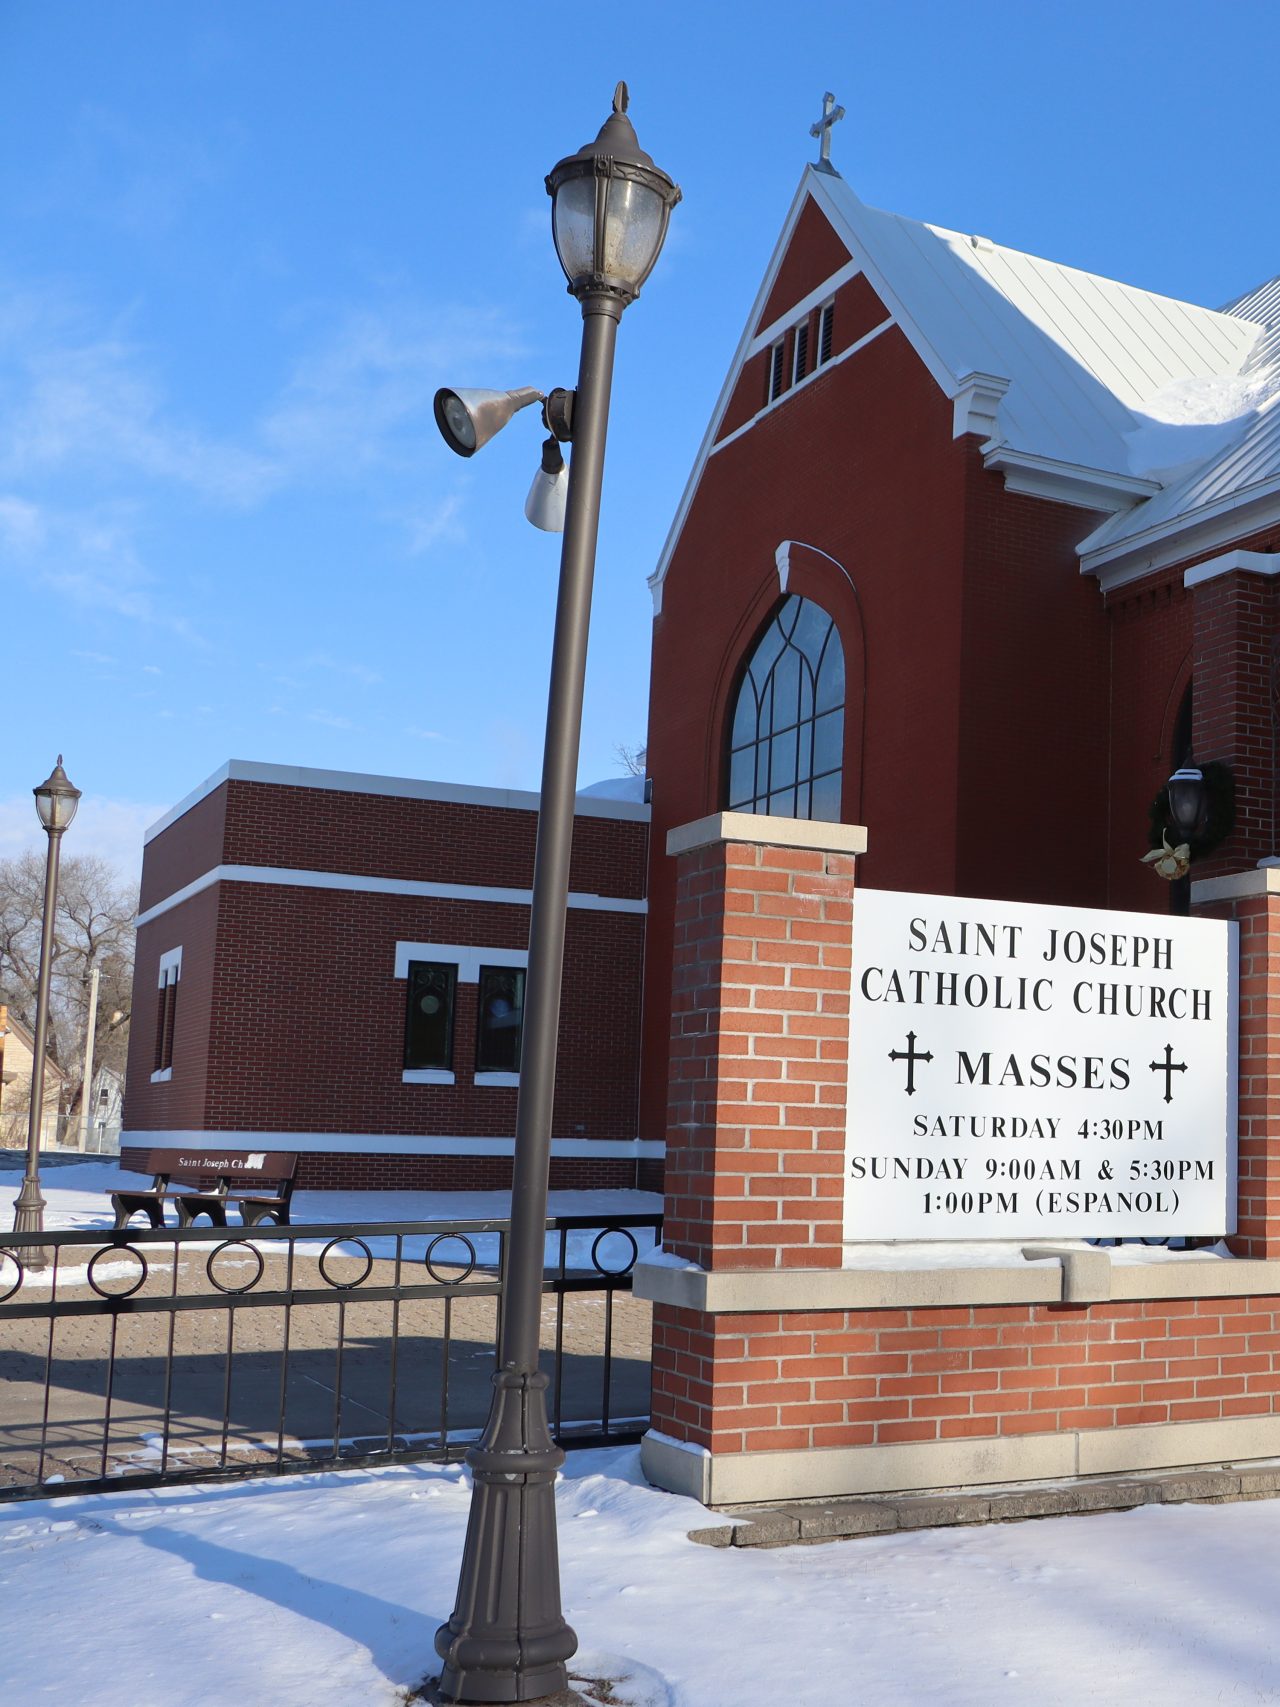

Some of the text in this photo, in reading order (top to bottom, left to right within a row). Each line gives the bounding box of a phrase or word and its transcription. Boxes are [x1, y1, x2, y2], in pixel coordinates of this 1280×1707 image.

[908, 917, 1174, 971] SAINT JOSEPH
[860, 966, 1213, 1021] CATHOLIC CHURCH
[955, 1050, 1131, 1091] MASSES
[912, 1114, 1165, 1141] SATURDAY 4:30PM
[178, 1157, 201, 1167] Saint
[202, 1158, 229, 1170] Joseph
[850, 1156, 1215, 1182] SUNDAY 9:00AM & 5:30PM
[923, 1189, 1180, 1216] 1:00PM (ESPANOL)
